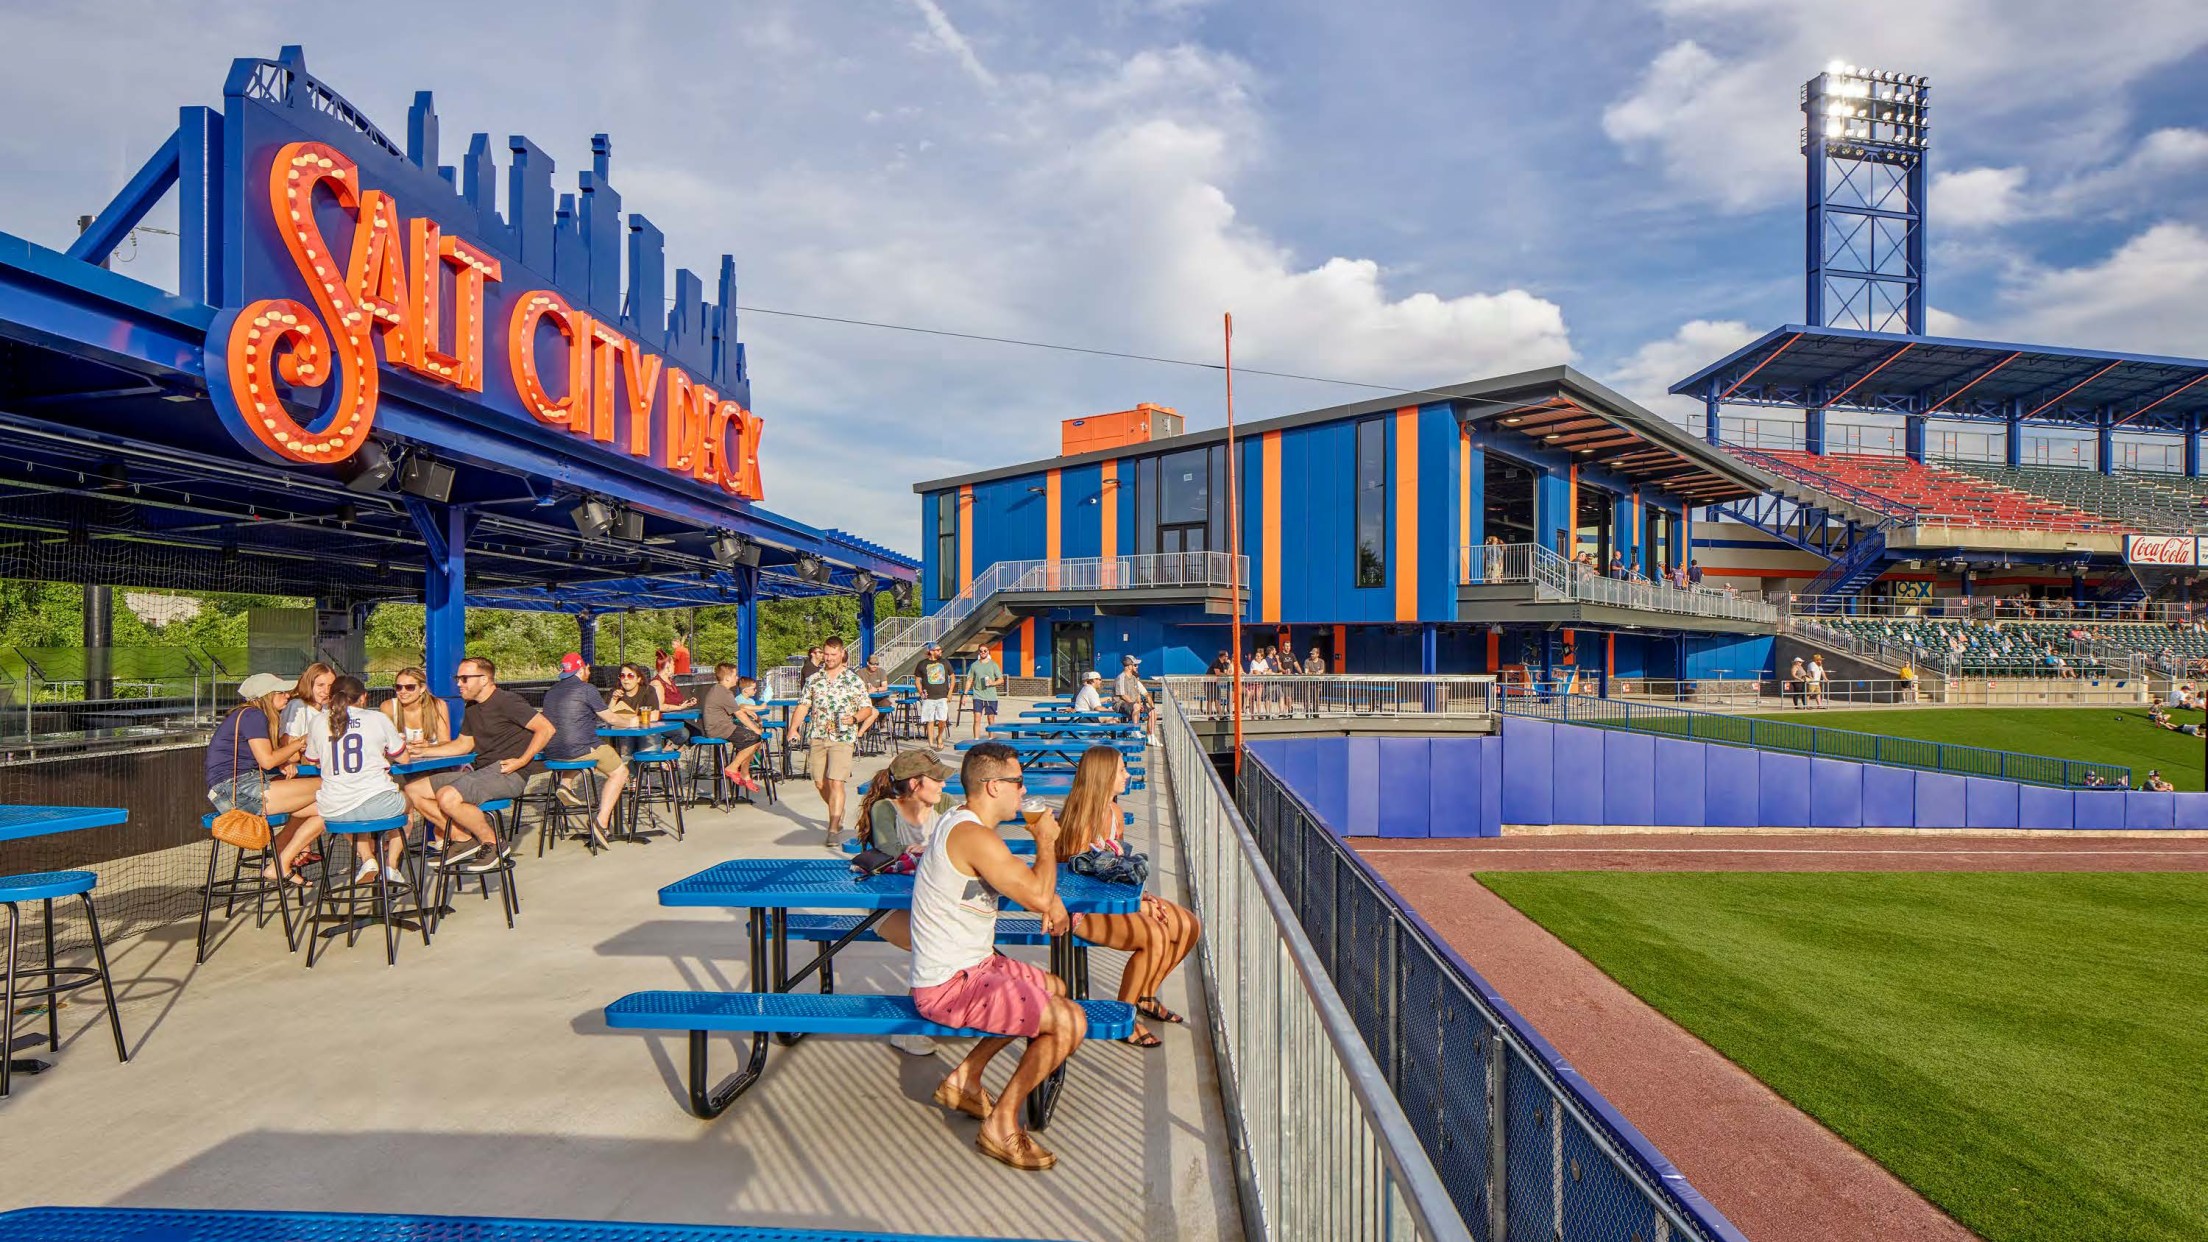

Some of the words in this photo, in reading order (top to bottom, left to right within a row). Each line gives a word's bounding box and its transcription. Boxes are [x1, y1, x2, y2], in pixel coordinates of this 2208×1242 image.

[509, 290, 663, 457] CITY
[667, 367, 765, 501] DECK
[2130, 537, 2192, 563] Coca-Cola
[1897, 581, 1931, 598] 95X
[328, 733, 363, 776] 18
